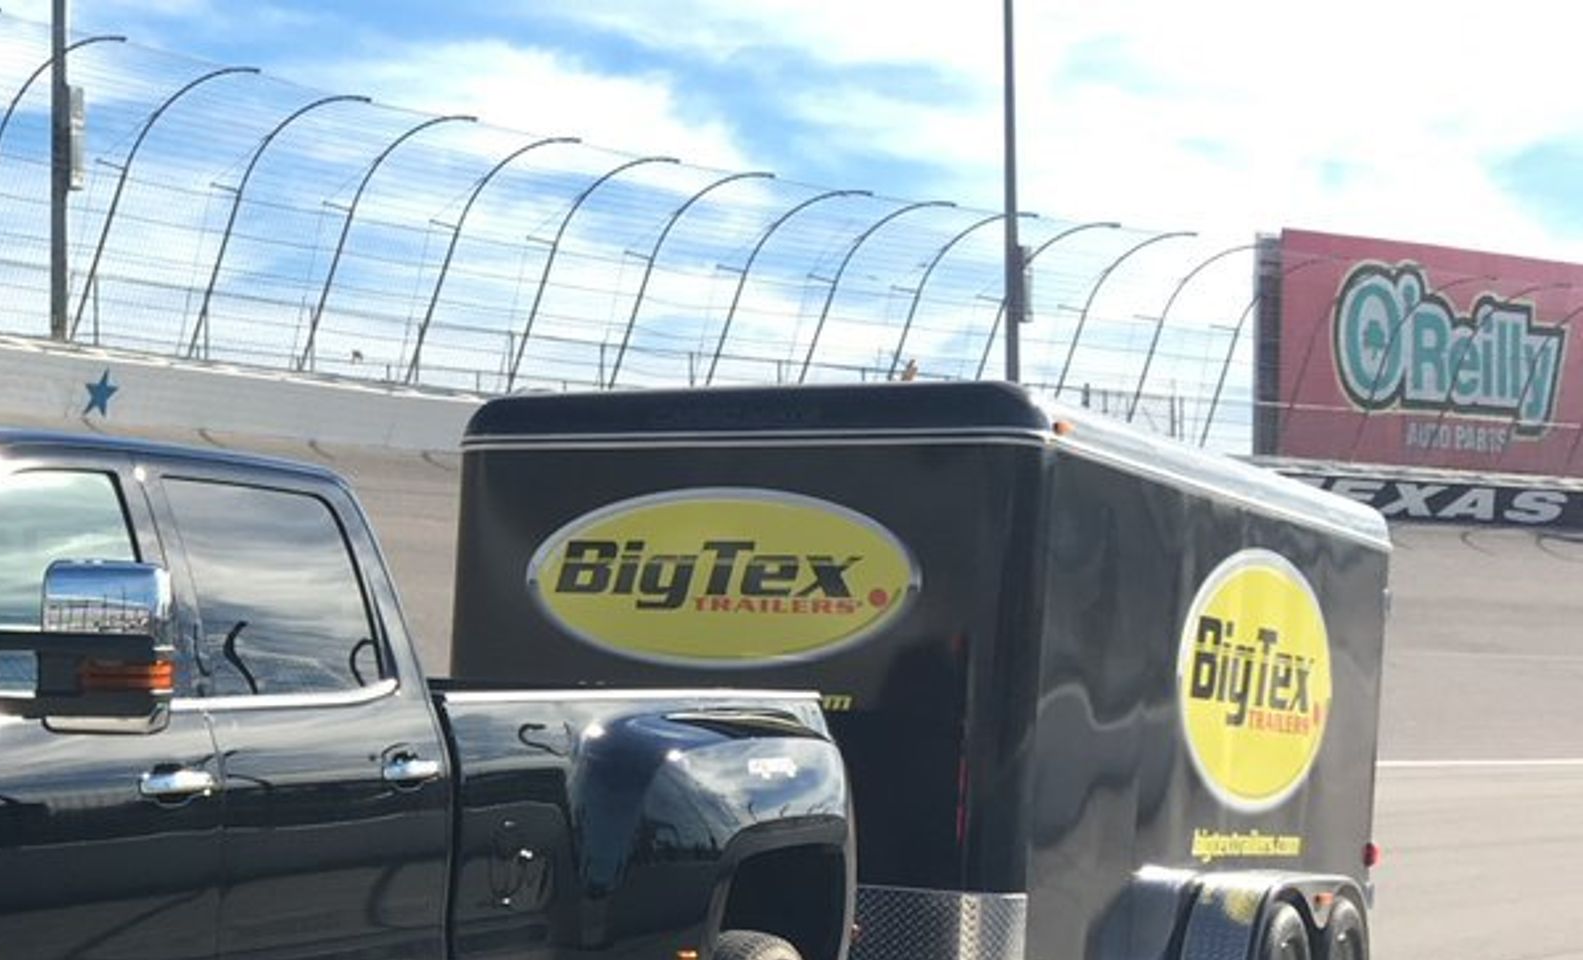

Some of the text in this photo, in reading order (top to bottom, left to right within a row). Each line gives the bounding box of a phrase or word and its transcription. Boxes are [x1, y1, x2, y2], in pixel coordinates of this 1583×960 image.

[1335, 265, 1563, 431] O'Reilly
[1406, 422, 1507, 454] AUTO PARTS
[1301, 477, 1568, 523] EXAS
[555, 540, 864, 610] BigTex
[694, 596, 859, 614] TRAILERS
[1190, 615, 1315, 727] BigTex
[1248, 710, 1311, 736] TRAILERS
